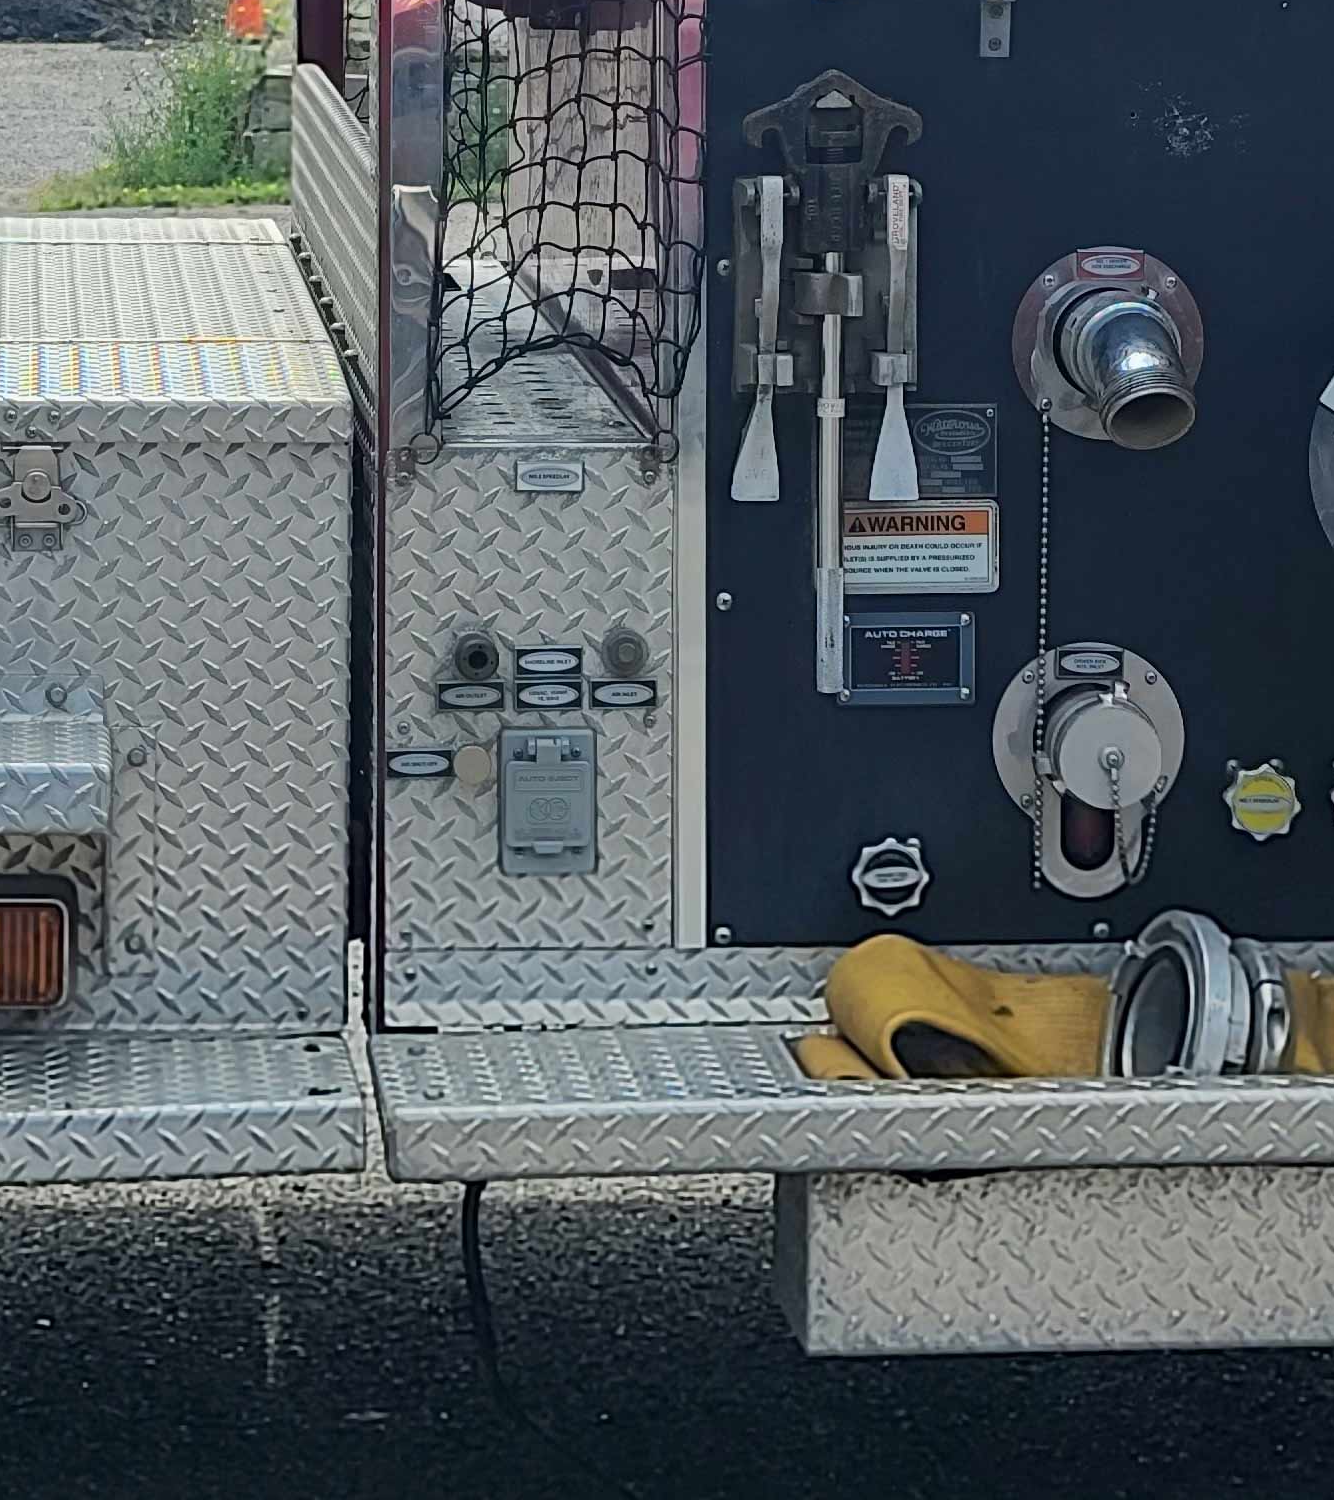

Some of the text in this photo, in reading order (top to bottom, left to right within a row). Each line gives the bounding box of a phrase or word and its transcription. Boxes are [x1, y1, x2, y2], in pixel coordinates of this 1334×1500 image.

[867, 514, 967, 533] WARNING
[864, 629, 948, 639] AUTO CHARGE
